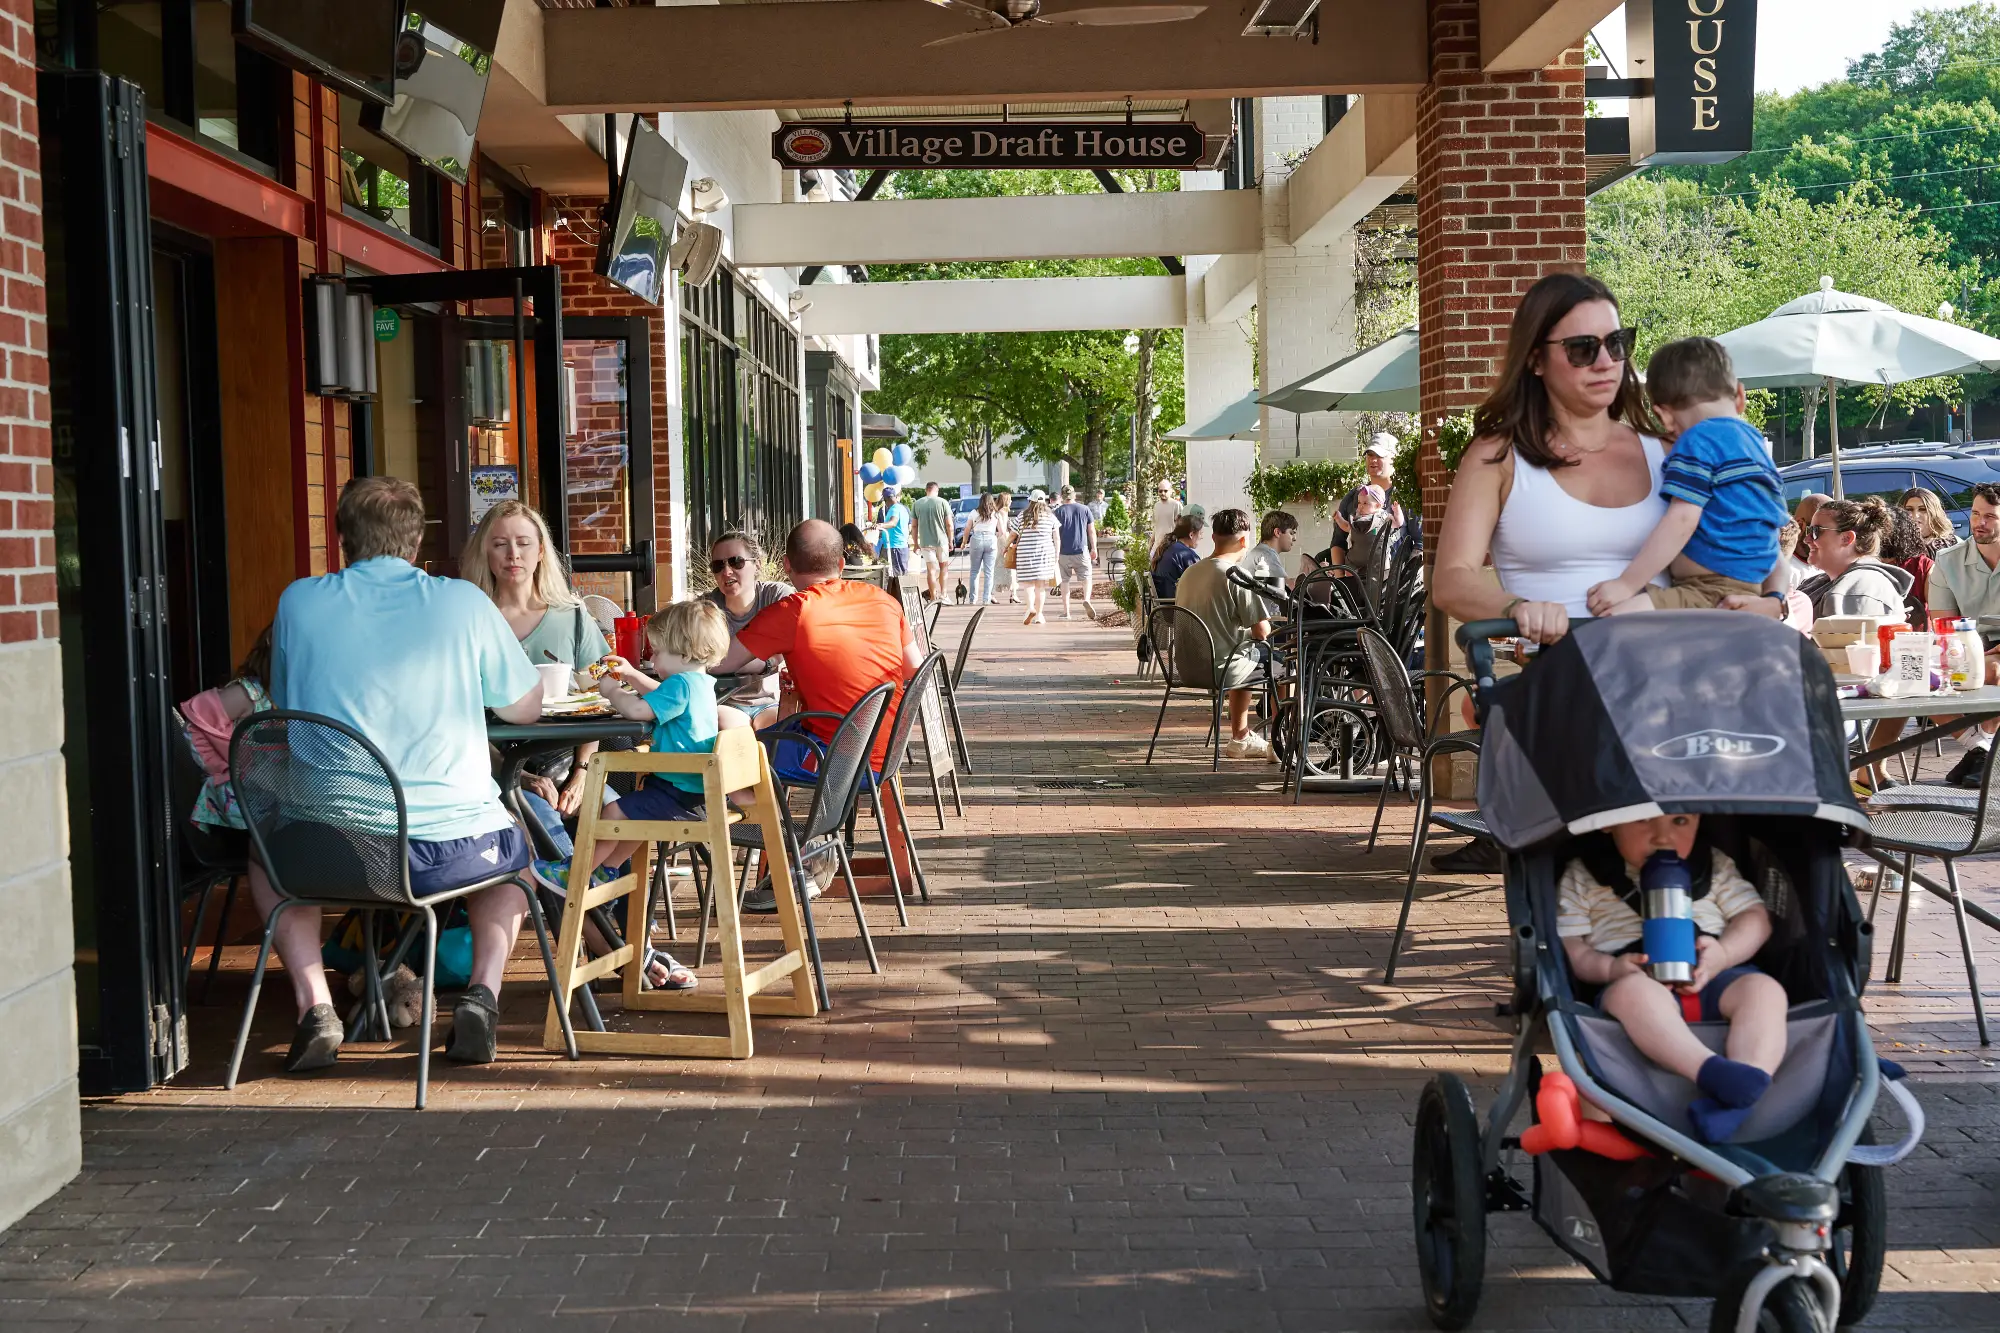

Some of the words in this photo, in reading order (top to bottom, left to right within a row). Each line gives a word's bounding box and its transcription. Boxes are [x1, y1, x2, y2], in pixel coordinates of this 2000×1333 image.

[838, 128, 963, 165] Village
[971, 128, 1064, 157] Draft
[1074, 130, 1187, 157] House
[376, 322, 395, 331] FAVE
